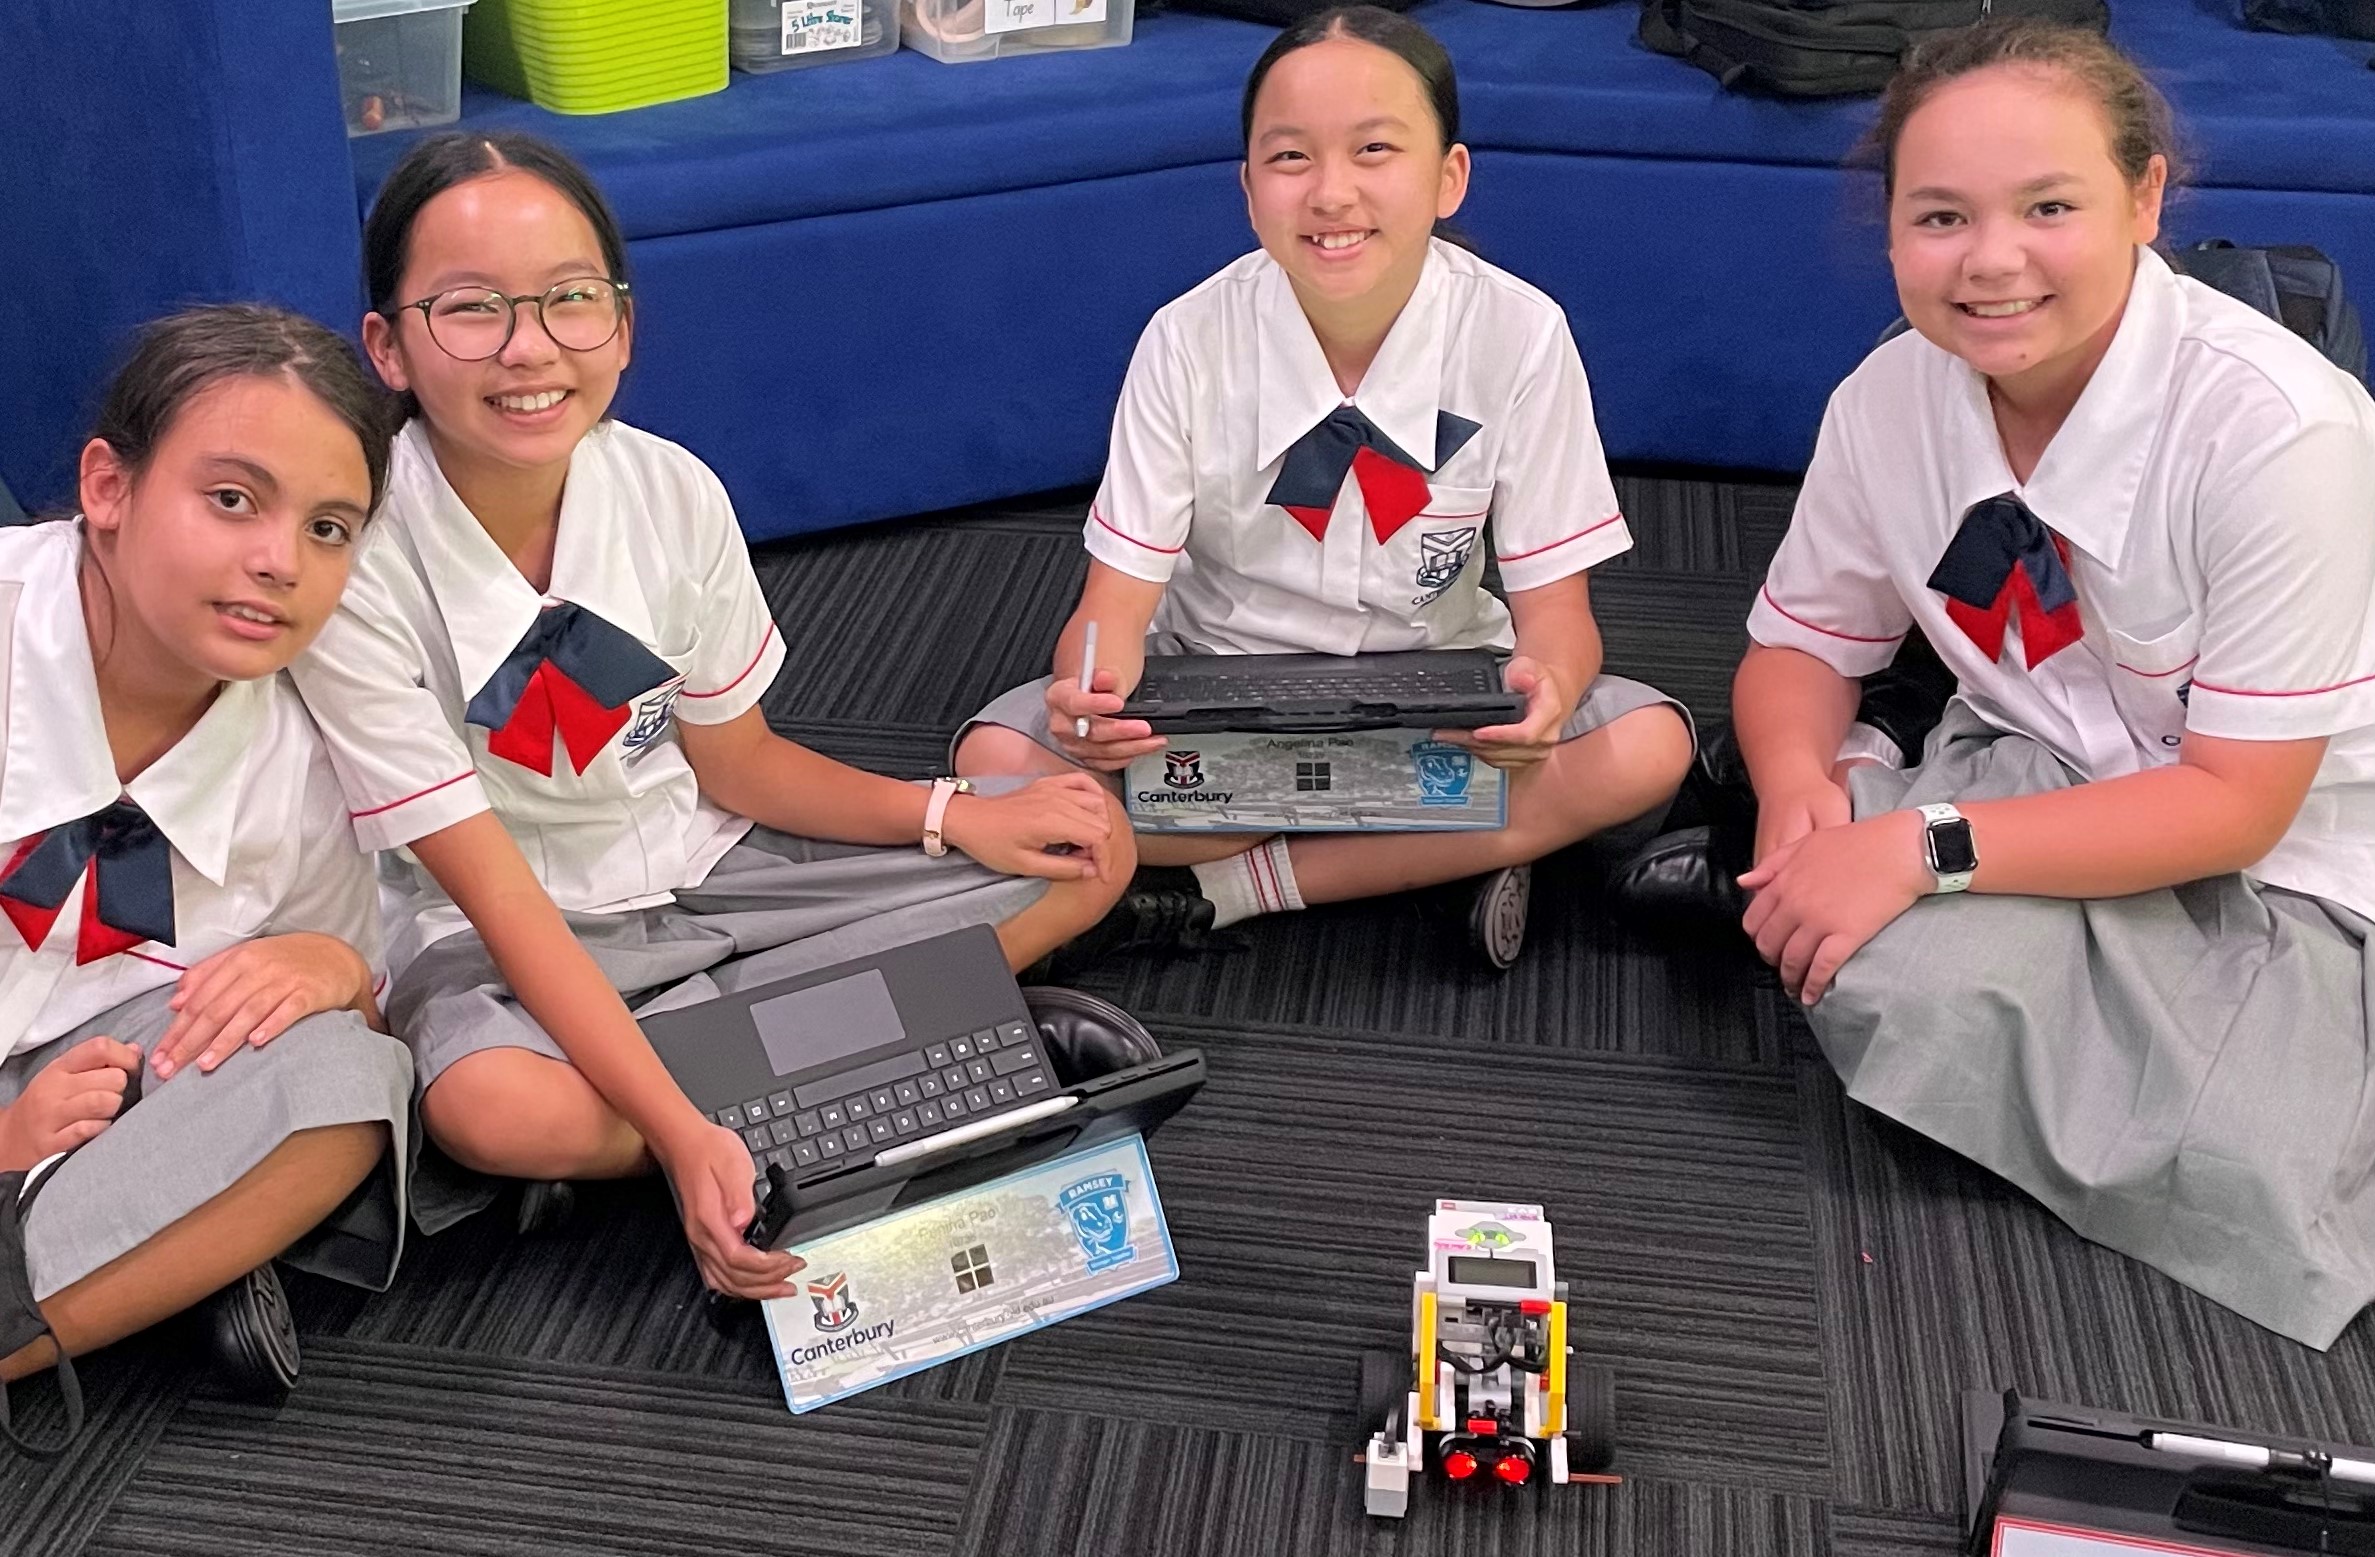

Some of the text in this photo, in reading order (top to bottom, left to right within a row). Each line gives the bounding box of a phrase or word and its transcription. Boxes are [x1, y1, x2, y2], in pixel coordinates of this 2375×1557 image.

[1004, 0, 1035, 23] Tape
[791, 18, 800, 33] 5
[1137, 790, 1233, 804] Canterbury
[1067, 1177, 1113, 1200] RAMSEY
[788, 1319, 895, 1366] Canterbury
